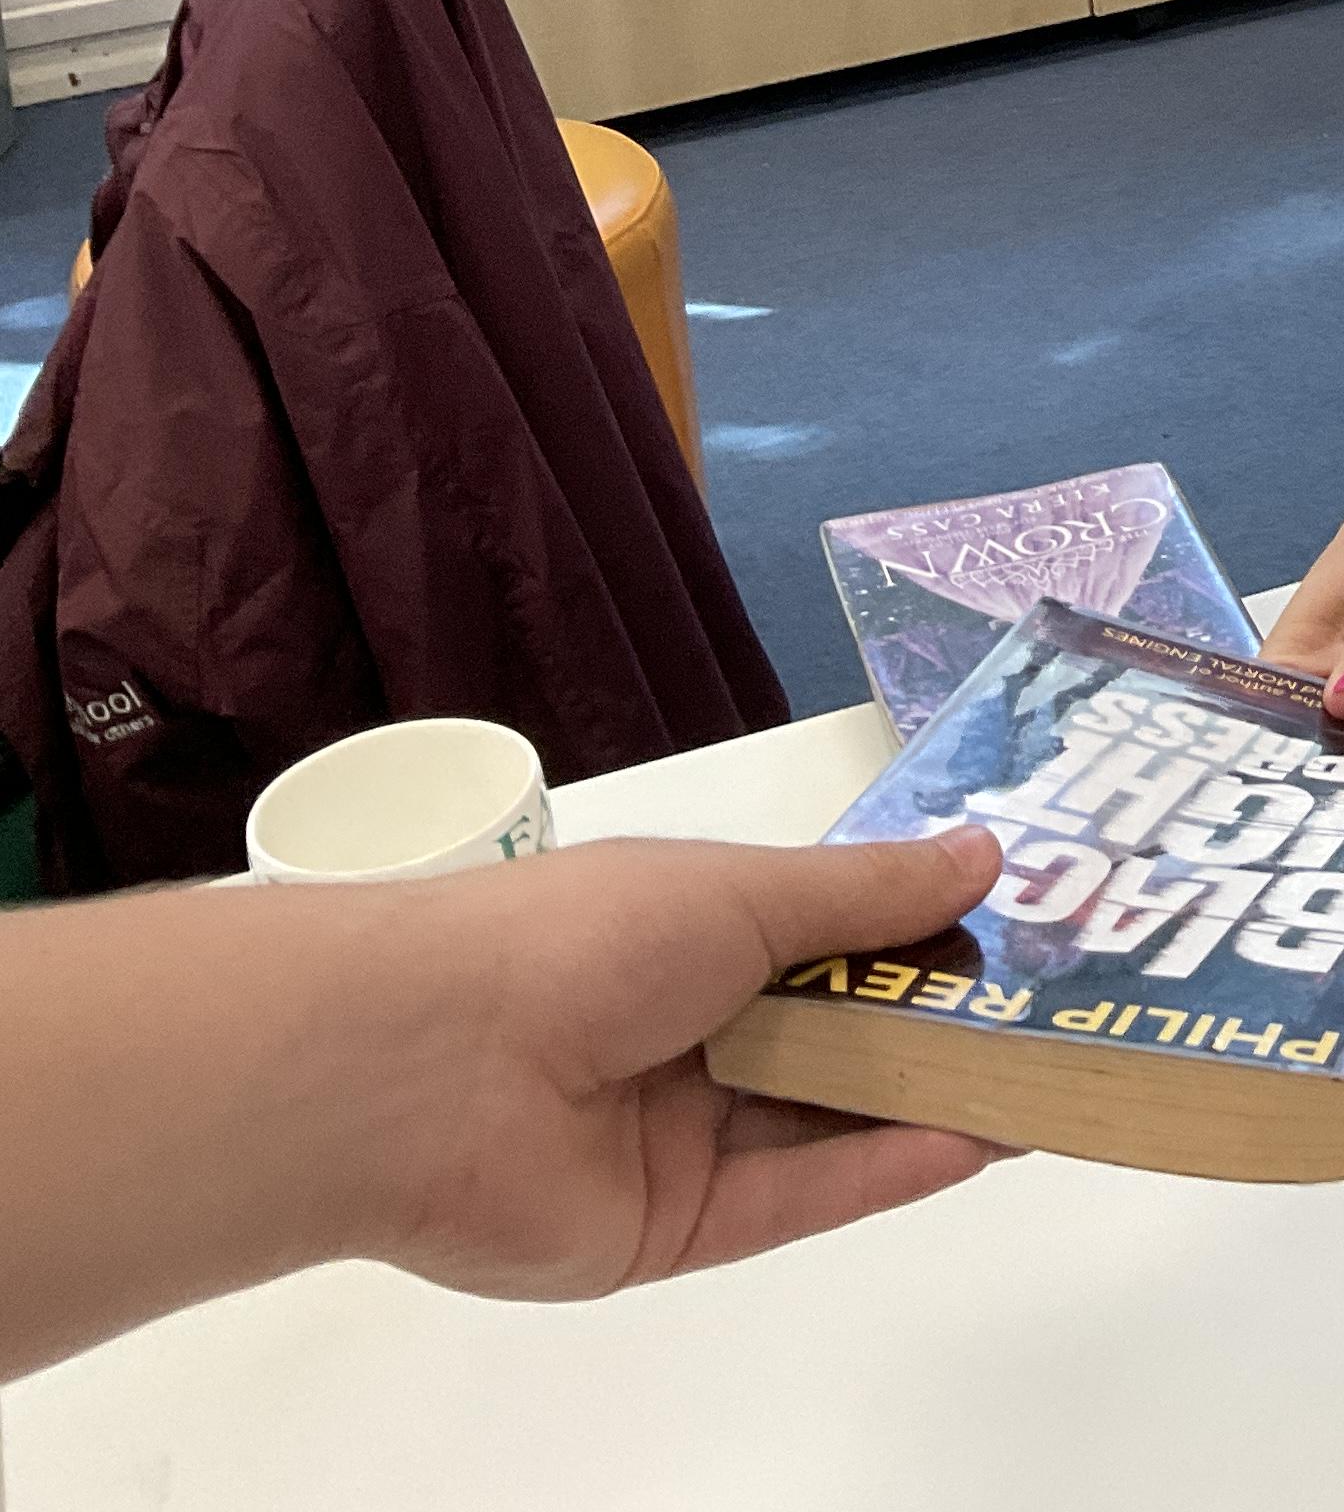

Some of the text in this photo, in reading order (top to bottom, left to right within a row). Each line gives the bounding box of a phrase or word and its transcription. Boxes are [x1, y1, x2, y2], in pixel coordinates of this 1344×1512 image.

[886, 483, 1111, 539] KIERA CASS
[879, 498, 1167, 588] CROWN
[1101, 625, 1202, 664] ENGINES
[1209, 656, 1298, 699] MORTAL
[788, 956, 1341, 1066] PHILIP REEV
